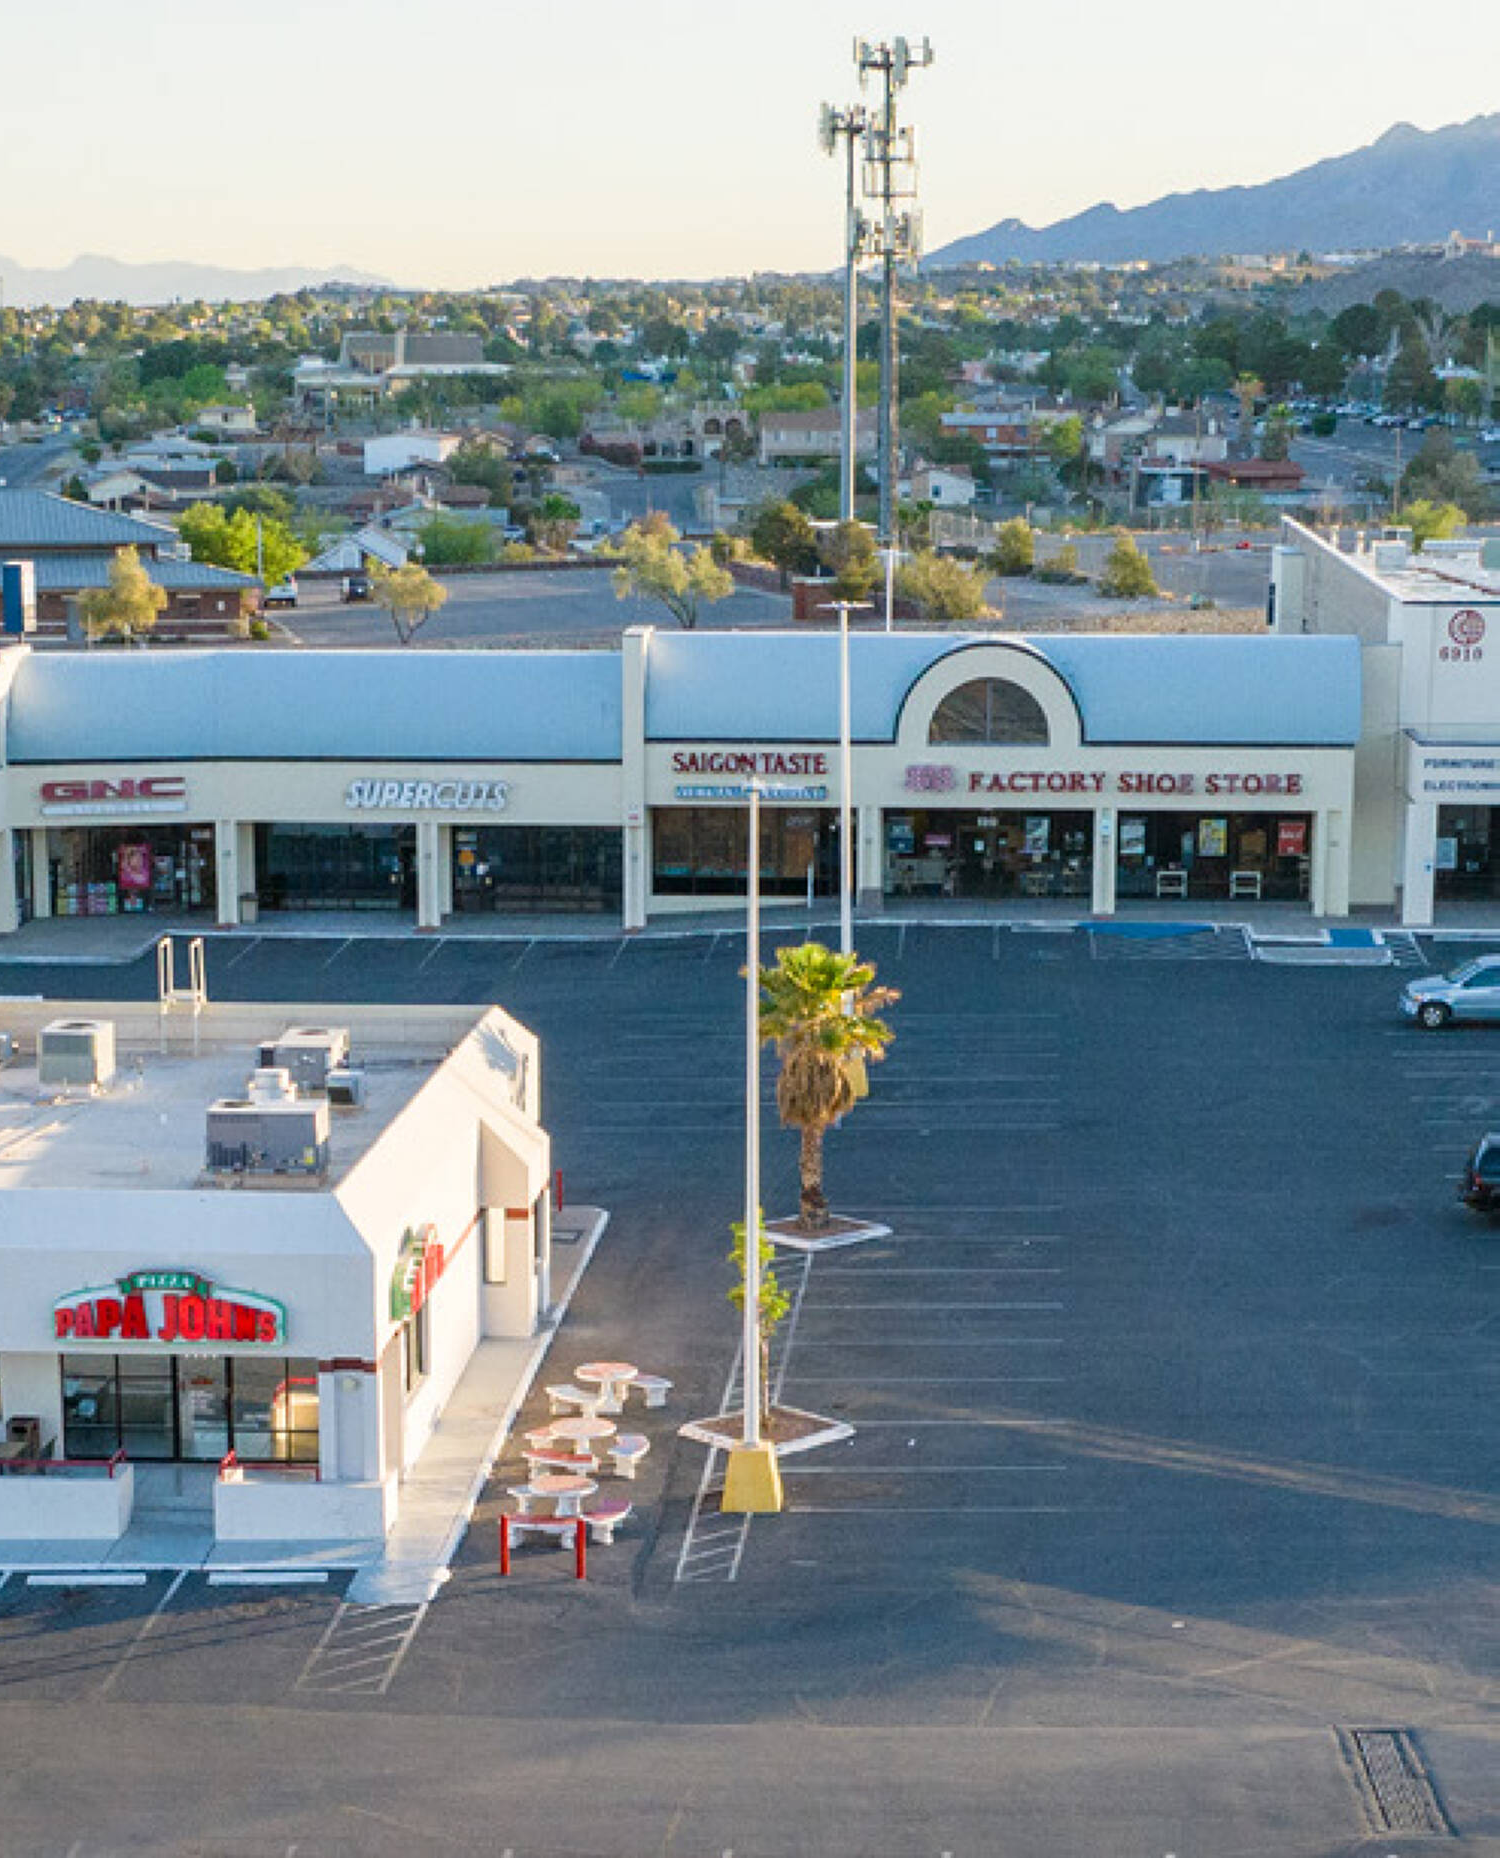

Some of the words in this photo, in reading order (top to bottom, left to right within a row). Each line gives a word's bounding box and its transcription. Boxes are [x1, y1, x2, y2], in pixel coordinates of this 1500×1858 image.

[672, 752, 757, 774] SAIGON
[761, 752, 828, 775] TASTE
[41, 776, 186, 802] GNC
[345, 777, 510, 812] SUPERCUTS
[968, 771, 1107, 793] FACTORY
[1117, 772, 1195, 794] SHOE
[1204, 773, 1303, 795] STORE
[135, 1274, 194, 1289] PIZZA
[53, 1294, 150, 1340] PAPA
